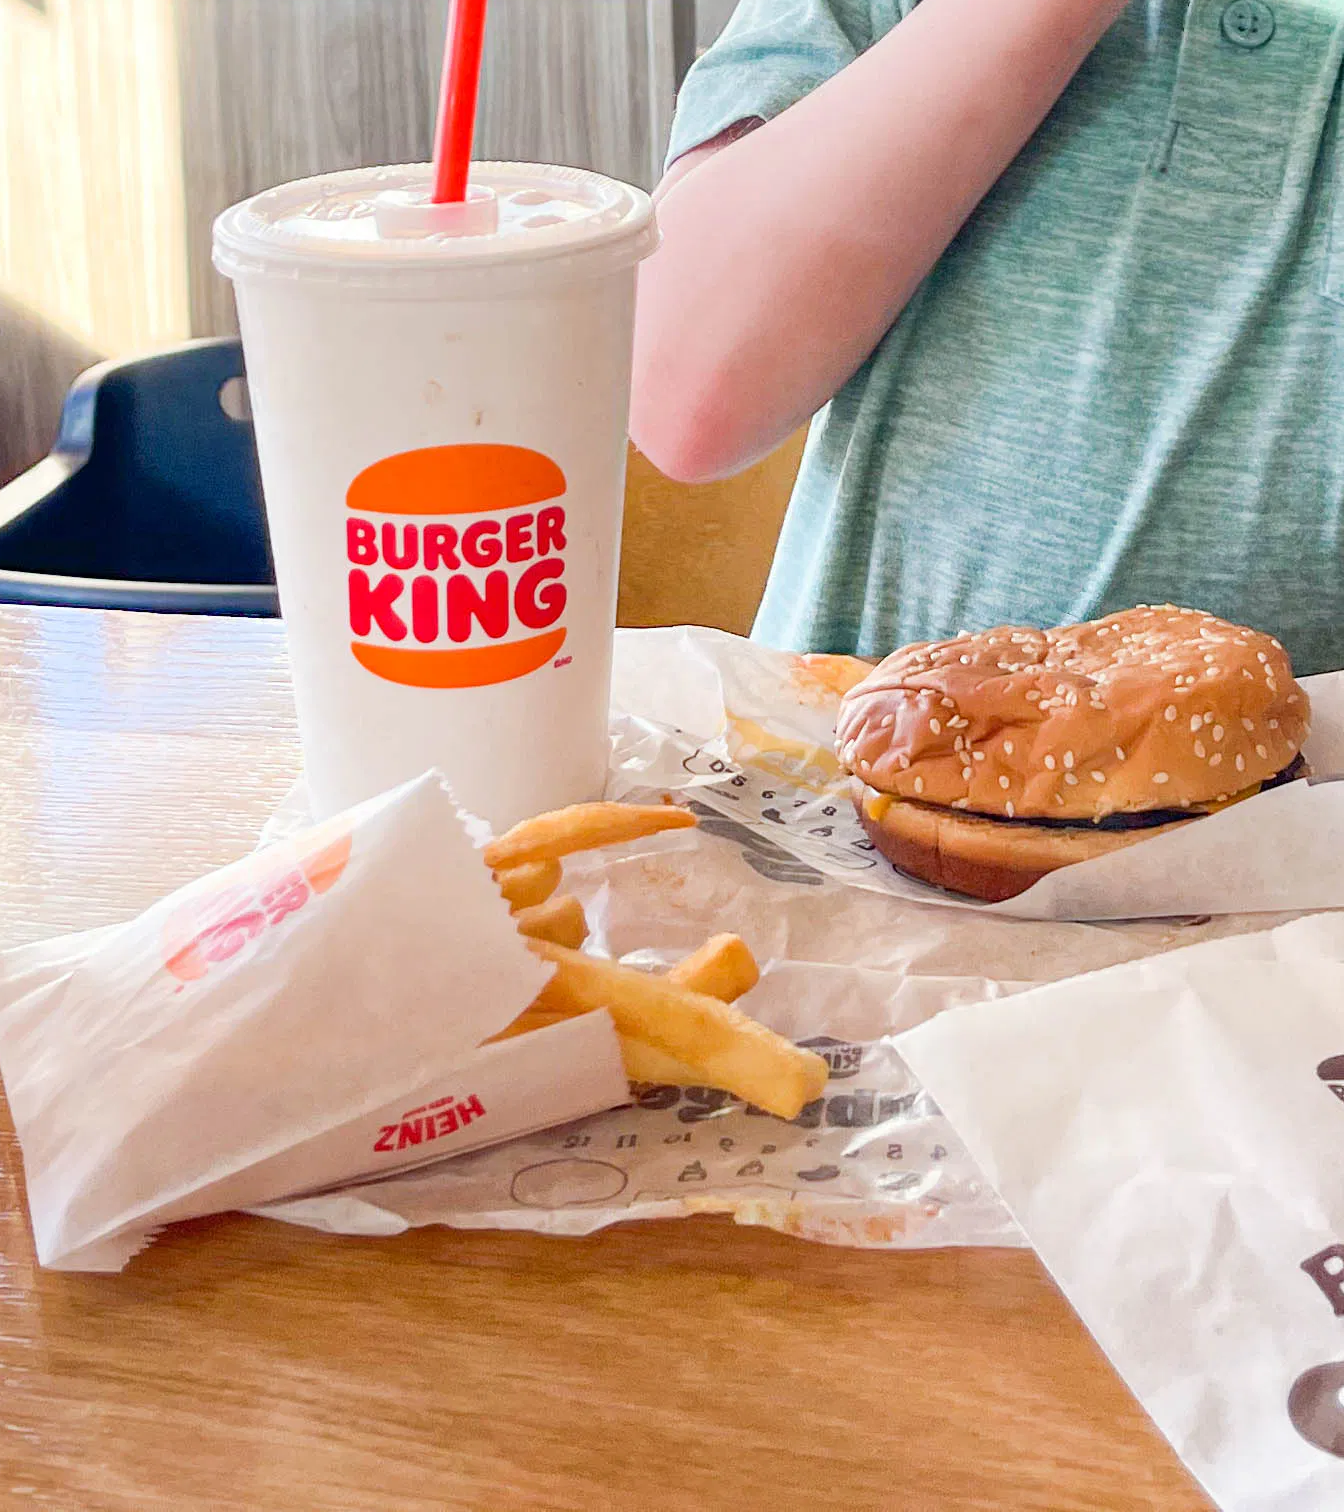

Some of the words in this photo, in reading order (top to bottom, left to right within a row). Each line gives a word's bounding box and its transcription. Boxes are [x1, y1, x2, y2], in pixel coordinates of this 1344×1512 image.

[346, 505, 567, 571] BURGER
[348, 557, 567, 644] KING
[372, 1093, 487, 1153] HEINZ
